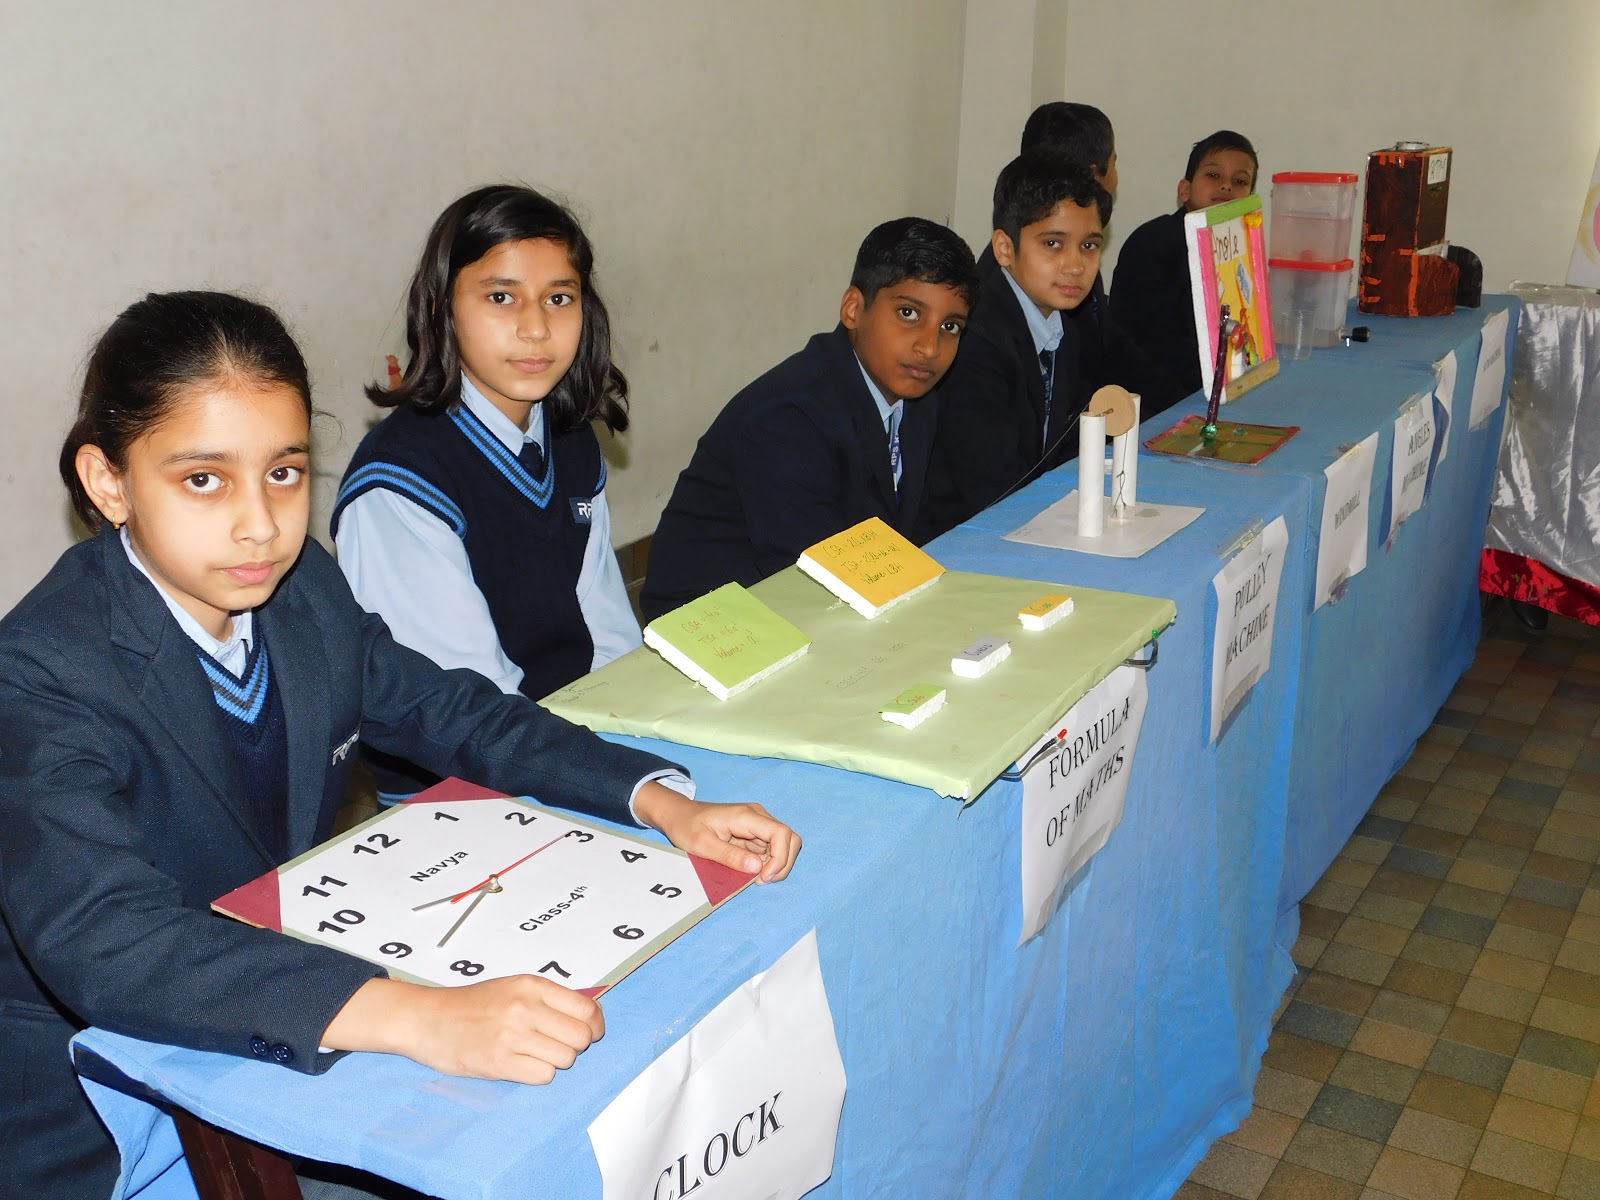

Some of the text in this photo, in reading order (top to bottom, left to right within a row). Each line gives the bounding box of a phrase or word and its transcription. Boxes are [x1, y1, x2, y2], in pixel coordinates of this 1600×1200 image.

[891, 446, 899, 465] RPS
[1234, 552, 1272, 617] PULLEY
[1225, 603, 1270, 672] MACHINE
[1049, 696, 1132, 791] FORMULA
[1046, 745, 1125, 848] OF MATHS
[434, 811, 460, 822] 1
[504, 811, 538, 826] 2
[353, 833, 402, 855] 12
[564, 829, 595, 843] 3
[620, 849, 648, 863] 4
[409, 851, 470, 882] Navya
[302, 875, 348, 898] 11
[649, 883, 683, 899] 5
[317, 909, 366, 934] 10
[612, 924, 645, 940] 6
[378, 941, 413, 959] 9
[449, 959, 485, 977] 8
[537, 960, 572, 979] 7
[653, 1090, 785, 1200] CLOCK
